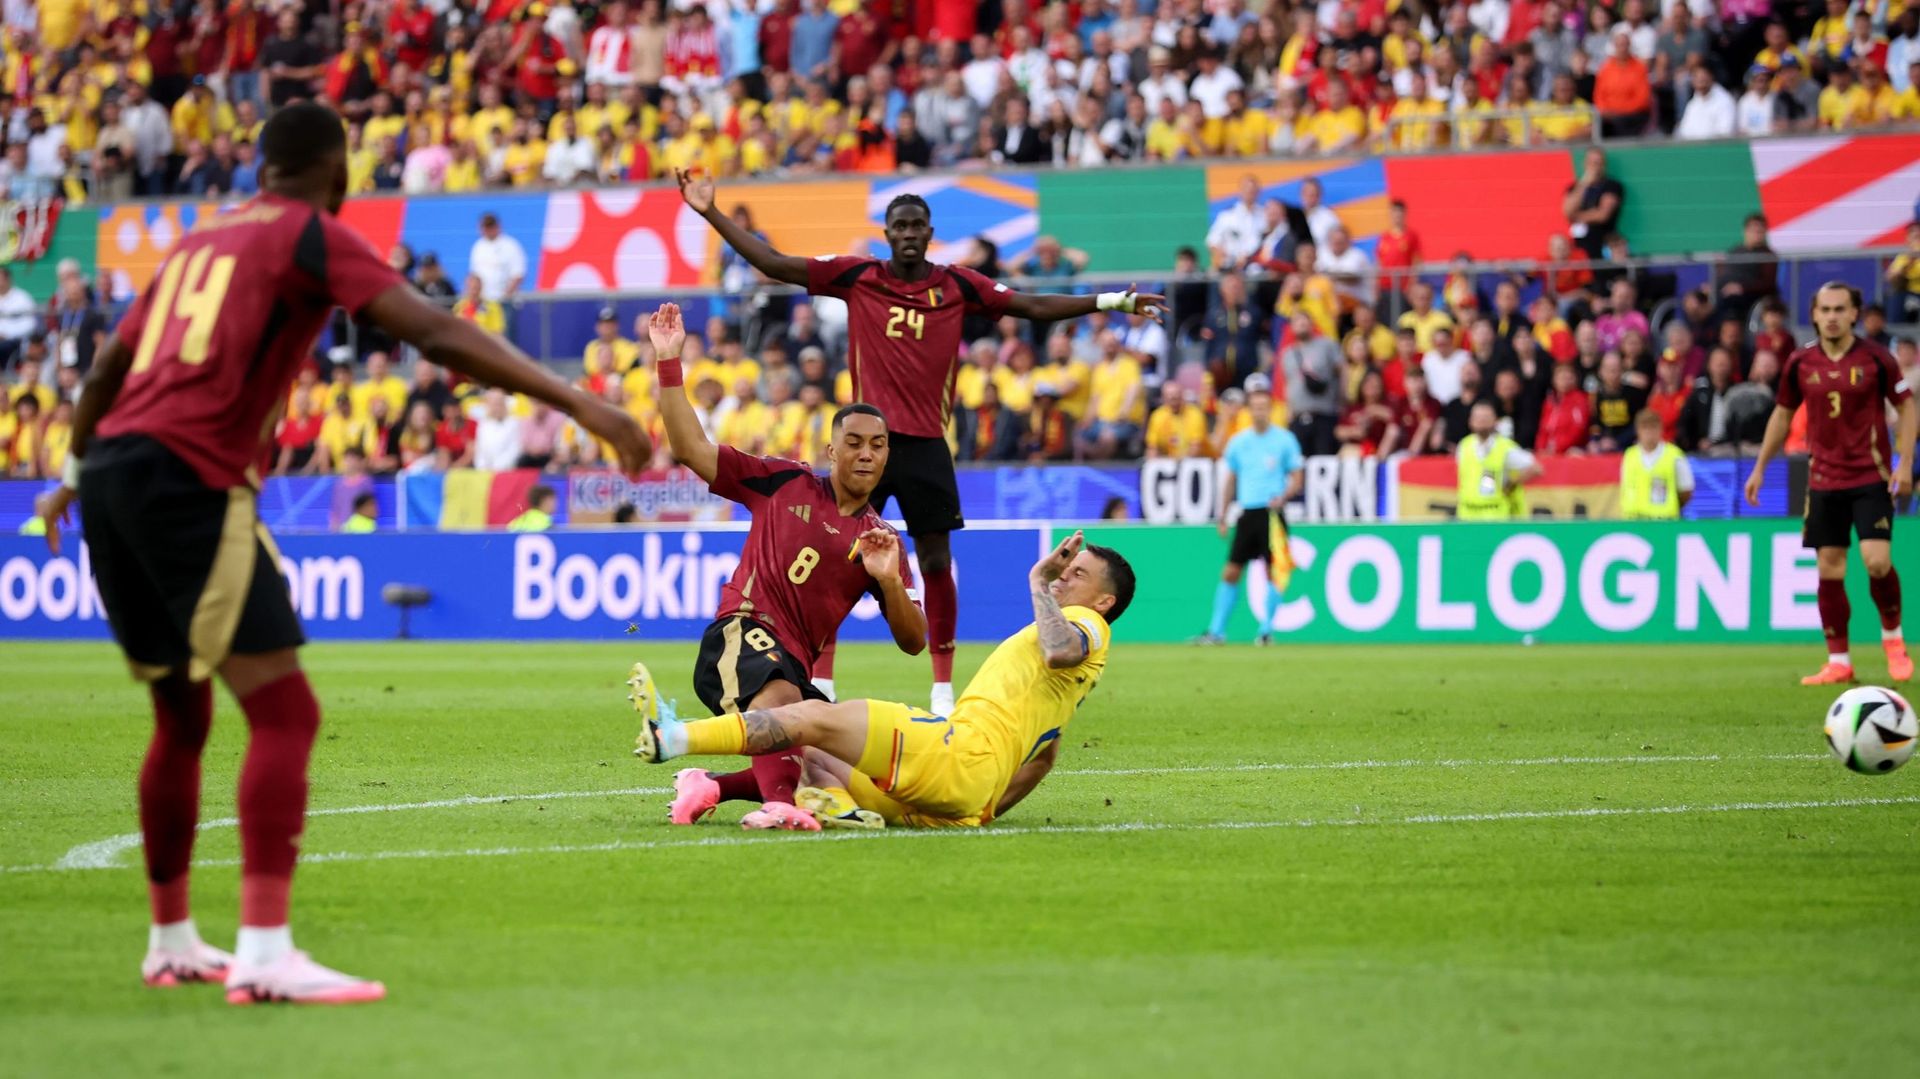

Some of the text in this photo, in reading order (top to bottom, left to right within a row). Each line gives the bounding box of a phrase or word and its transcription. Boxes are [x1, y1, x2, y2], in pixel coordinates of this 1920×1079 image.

[132, 244, 236, 374] 14
[885, 306, 925, 340] 24
[1827, 391, 1841, 418] 3
[513, 532, 741, 621] Bookin
[788, 546, 820, 585] 8
[744, 627, 776, 652] 8
